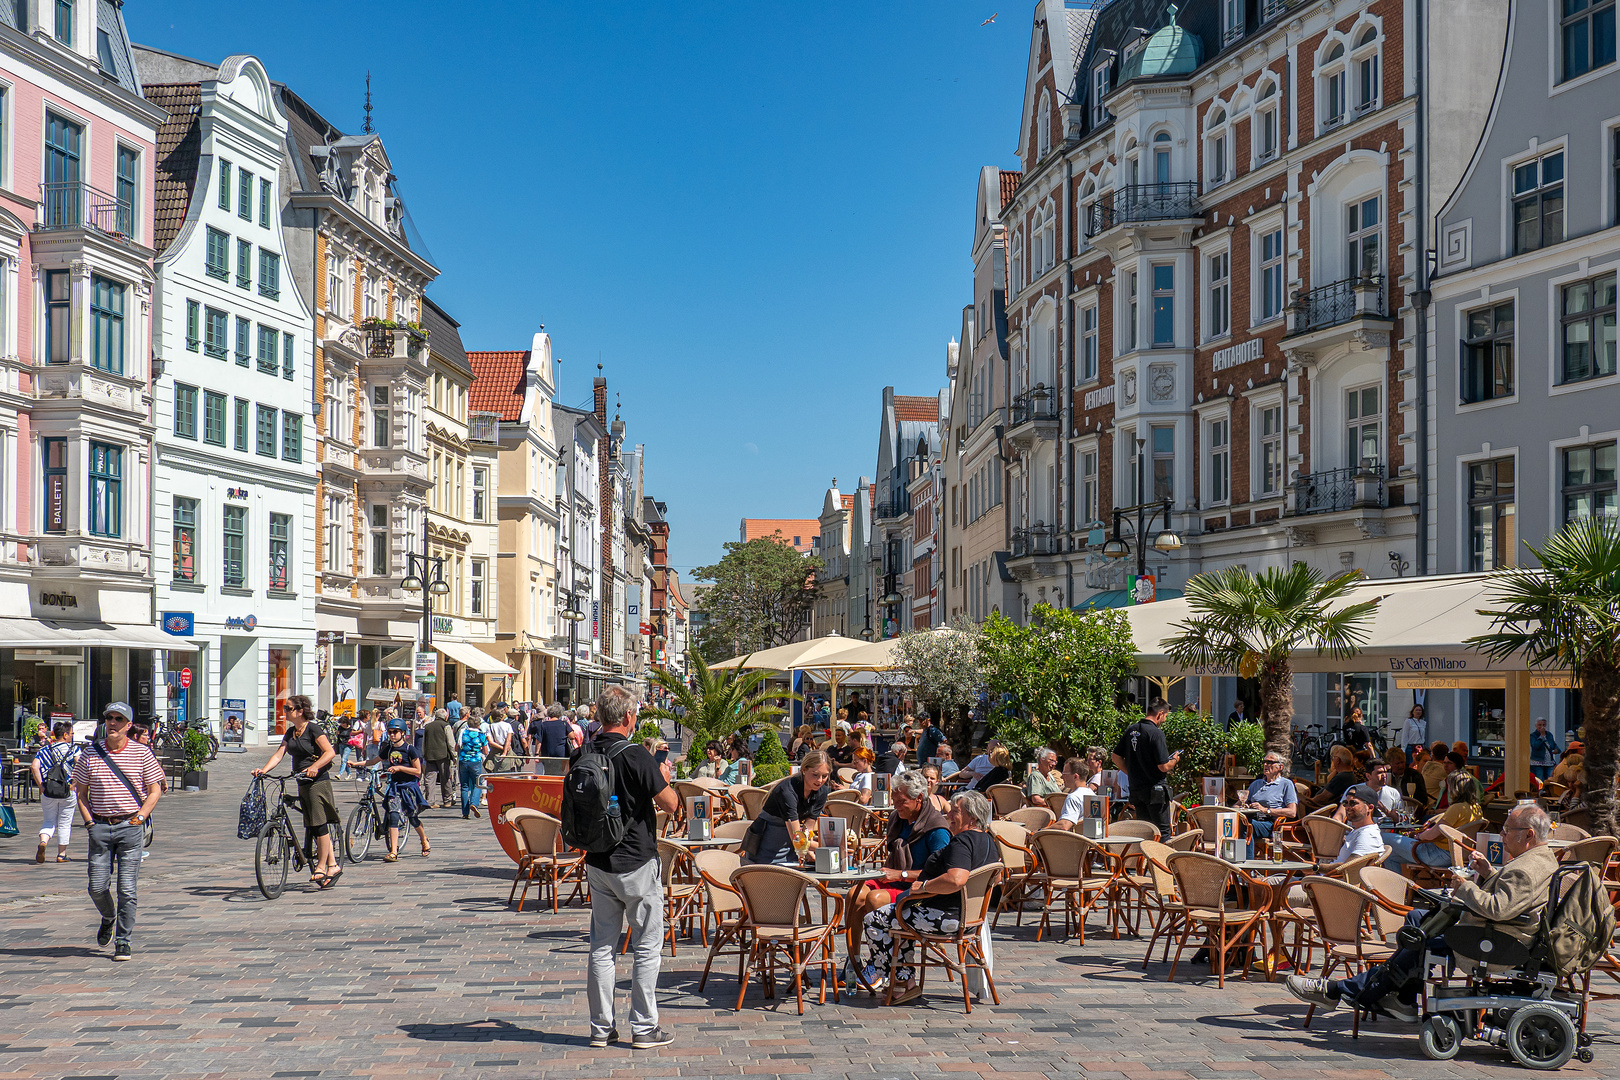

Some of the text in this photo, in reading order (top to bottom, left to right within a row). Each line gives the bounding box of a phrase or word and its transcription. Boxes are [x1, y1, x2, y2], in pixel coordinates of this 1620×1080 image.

[1212, 338, 1265, 372] PENTAHOTEL
[1085, 384, 1115, 410] PENTAHOT
[53, 481, 62, 524] BALLETT
[1405, 657, 1430, 670] Cafe
[1430, 657, 1467, 670] Milano
